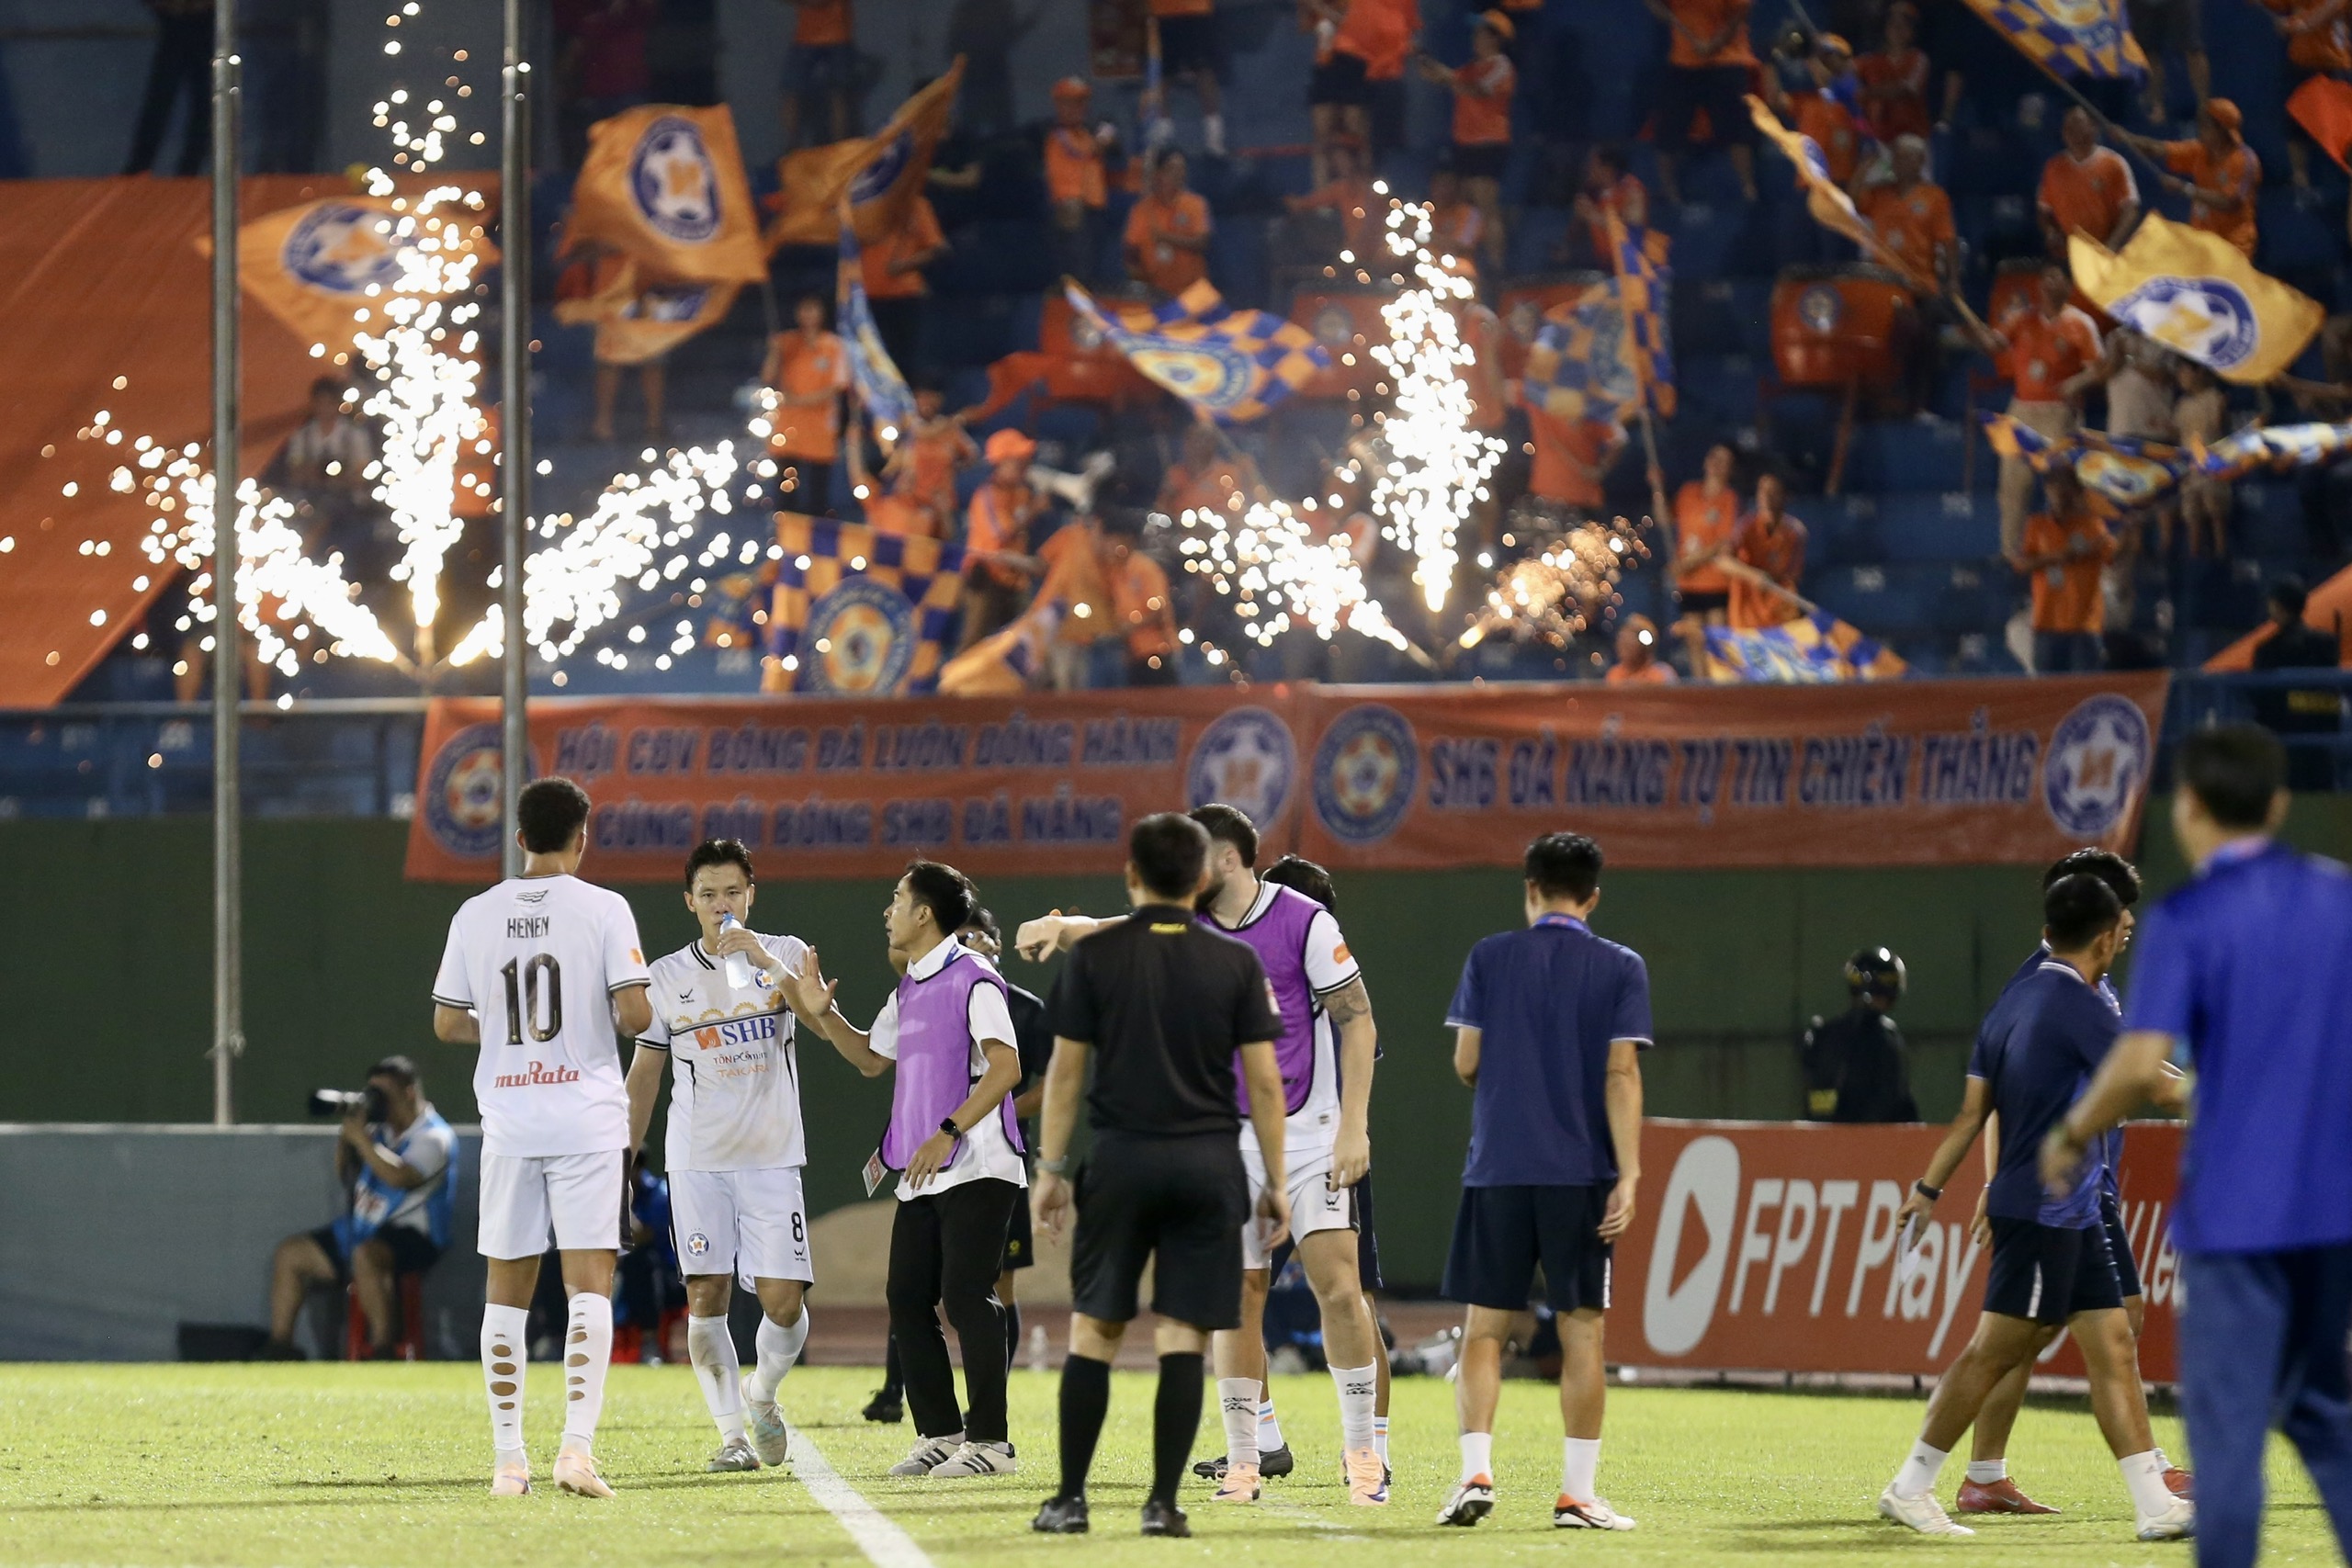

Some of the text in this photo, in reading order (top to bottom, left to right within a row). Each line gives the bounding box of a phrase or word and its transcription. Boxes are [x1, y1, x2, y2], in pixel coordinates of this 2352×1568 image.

[1430, 737, 1498, 808] SHB
[1732, 735, 1793, 807] TIN
[1798, 713, 1910, 807] CHIẾN
[883, 799, 952, 846] SHB
[506, 916, 549, 939] HENEN
[500, 952, 561, 1045] 10
[720, 1017, 776, 1046] SHB
[791, 1212, 804, 1242] 8
[1728, 1178, 1983, 1359] FPT Play
